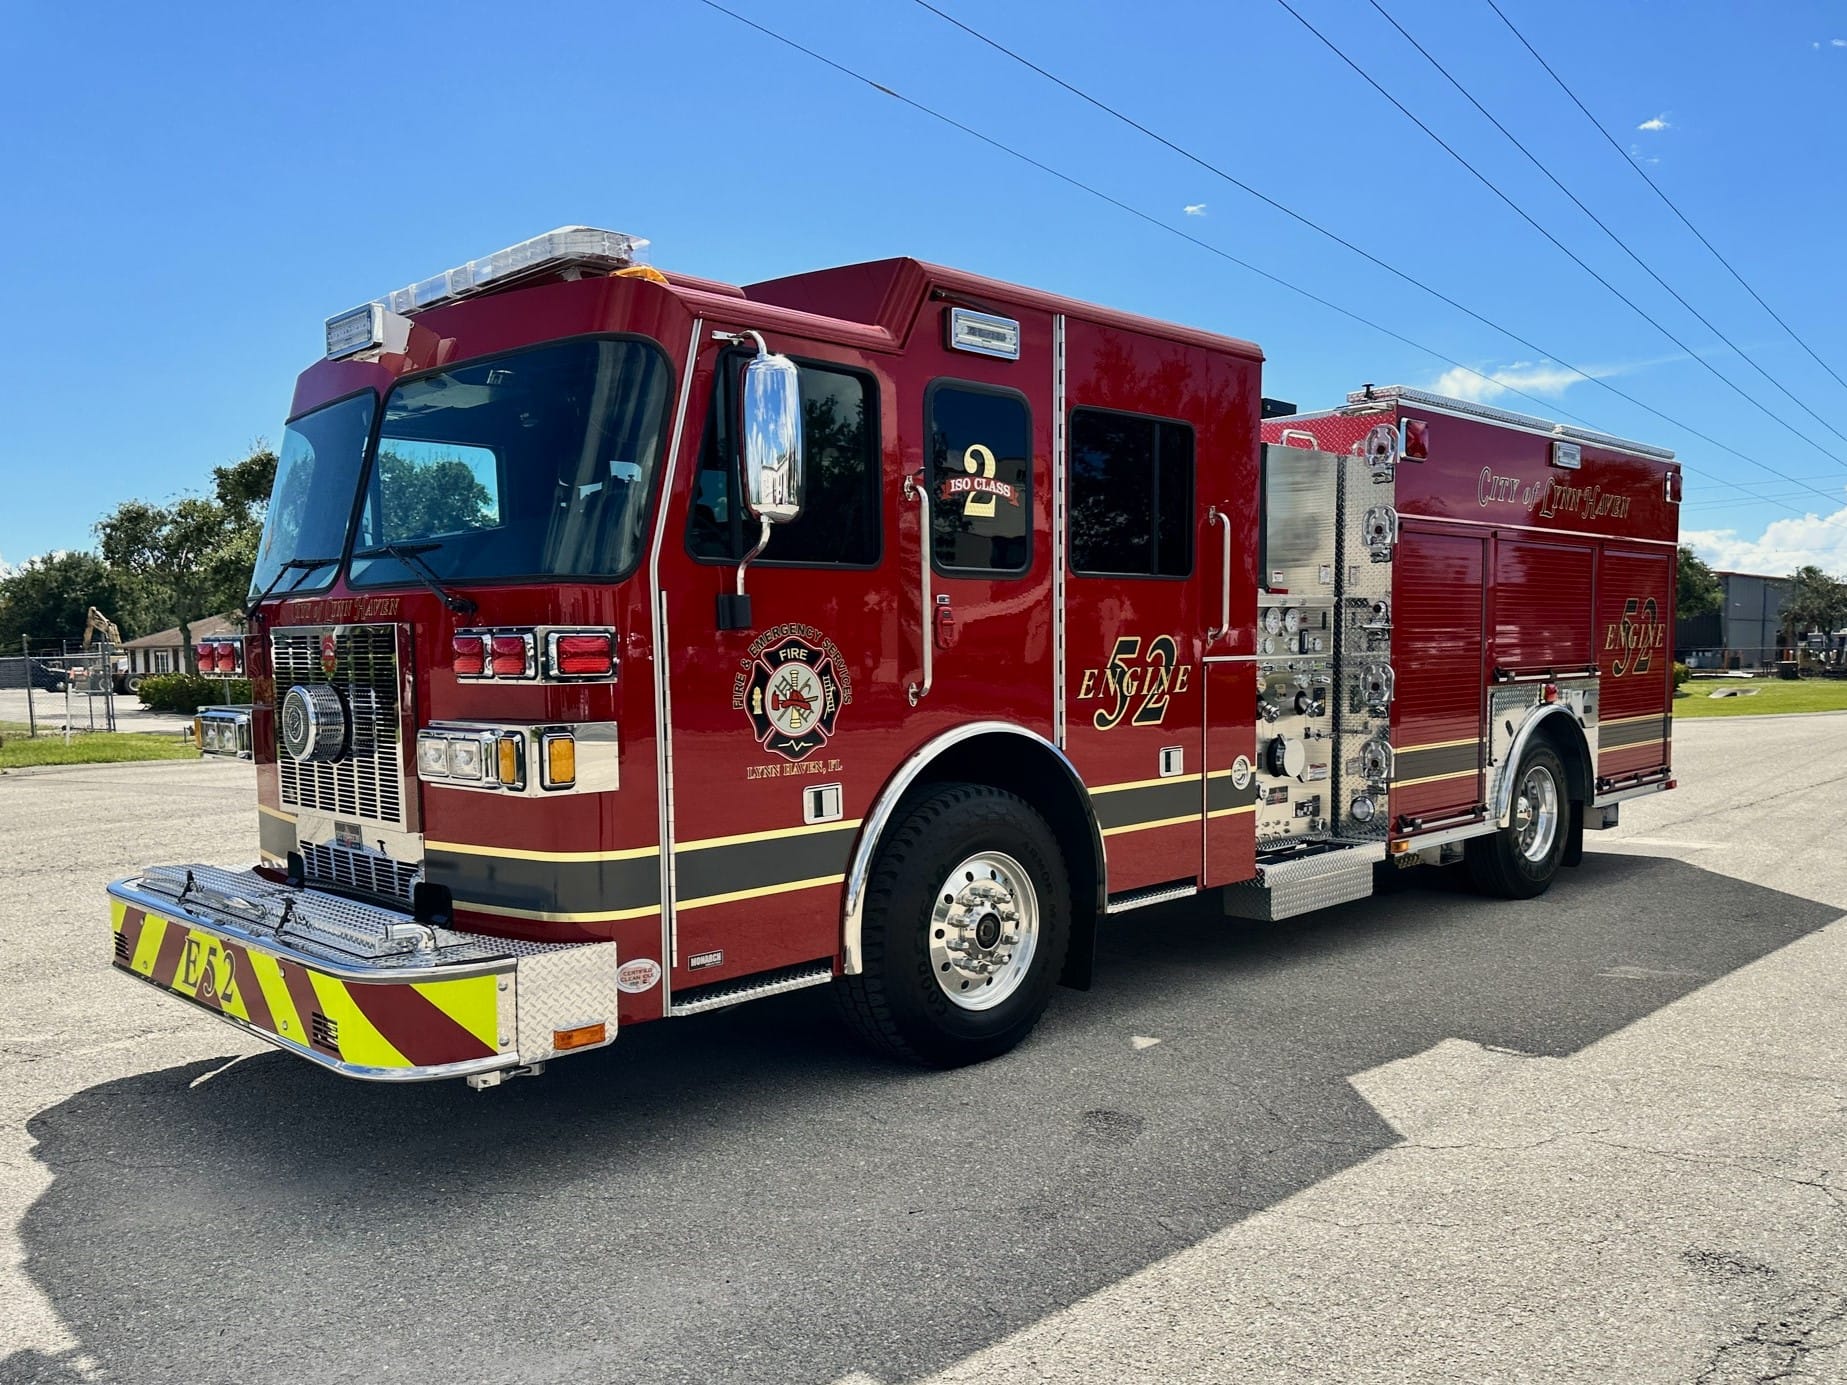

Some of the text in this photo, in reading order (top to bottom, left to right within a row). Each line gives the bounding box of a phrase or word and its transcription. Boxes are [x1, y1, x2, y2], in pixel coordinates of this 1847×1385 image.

[950, 478, 1011, 497] ISO CLASS
[963, 443, 996, 517] 2
[1477, 465, 1520, 507] CITY
[1522, 481, 1540, 512] of
[1581, 485, 1631, 520] HAVEN
[353, 594, 400, 621] HAVEN
[1604, 624, 1665, 650] ENGINE
[1612, 597, 1657, 677] 52
[732, 622, 853, 709] FIRE & EMERGENCY SERVICES
[778, 648, 809, 661] FIRE
[1076, 665, 1192, 699] ENGINE
[1093, 634, 1177, 731] 52
[747, 764, 780, 780] LYNN
[182, 935, 236, 1003] E52
[690, 952, 722, 968] MONARCH
